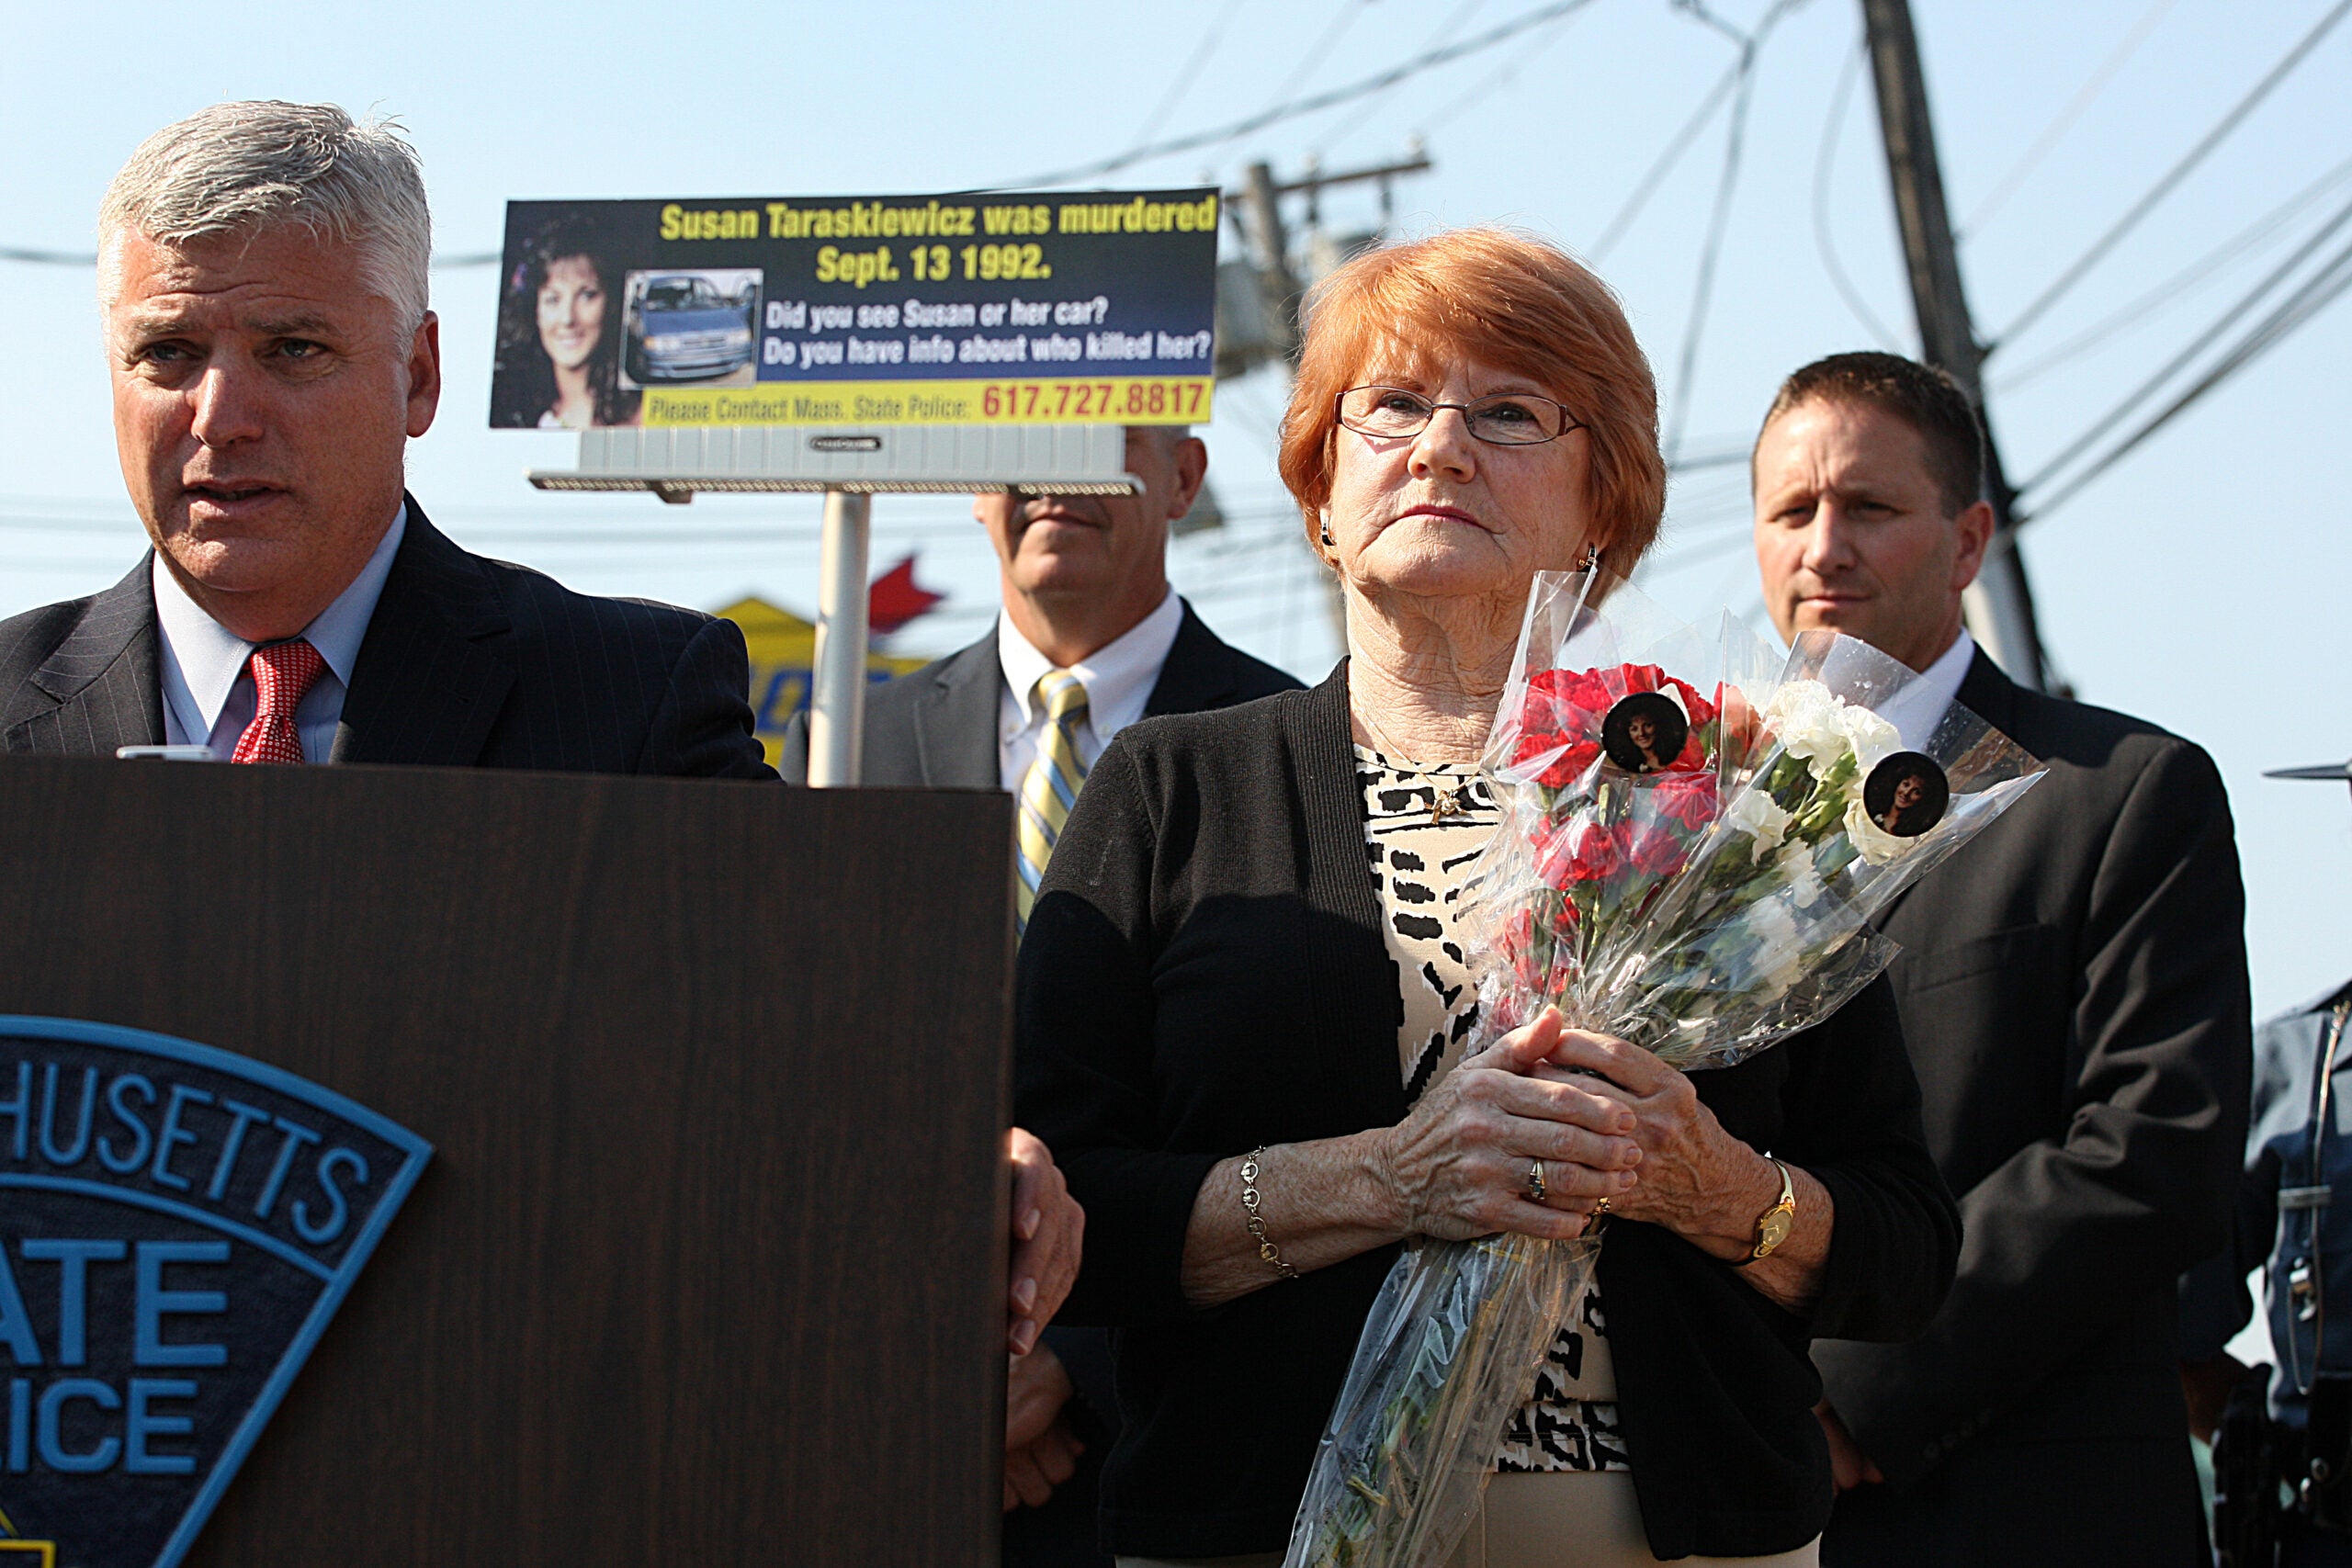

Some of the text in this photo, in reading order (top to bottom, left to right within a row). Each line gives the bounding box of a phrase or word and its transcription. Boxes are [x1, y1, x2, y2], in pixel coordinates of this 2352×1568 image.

[660, 195, 1217, 241] Susan Taraskiewicz was murdered
[816, 243, 1052, 288] Sept. 13 1992.
[766, 295, 1109, 334] Did you see Susan or her car?
[763, 330, 1212, 370] Do you have info about who killed her?
[650, 397, 710, 422] Please
[717, 396, 787, 421] Contact
[794, 396, 844, 420] Mass.
[854, 394, 903, 420] State
[983, 382, 1204, 419] 617.727.8817
